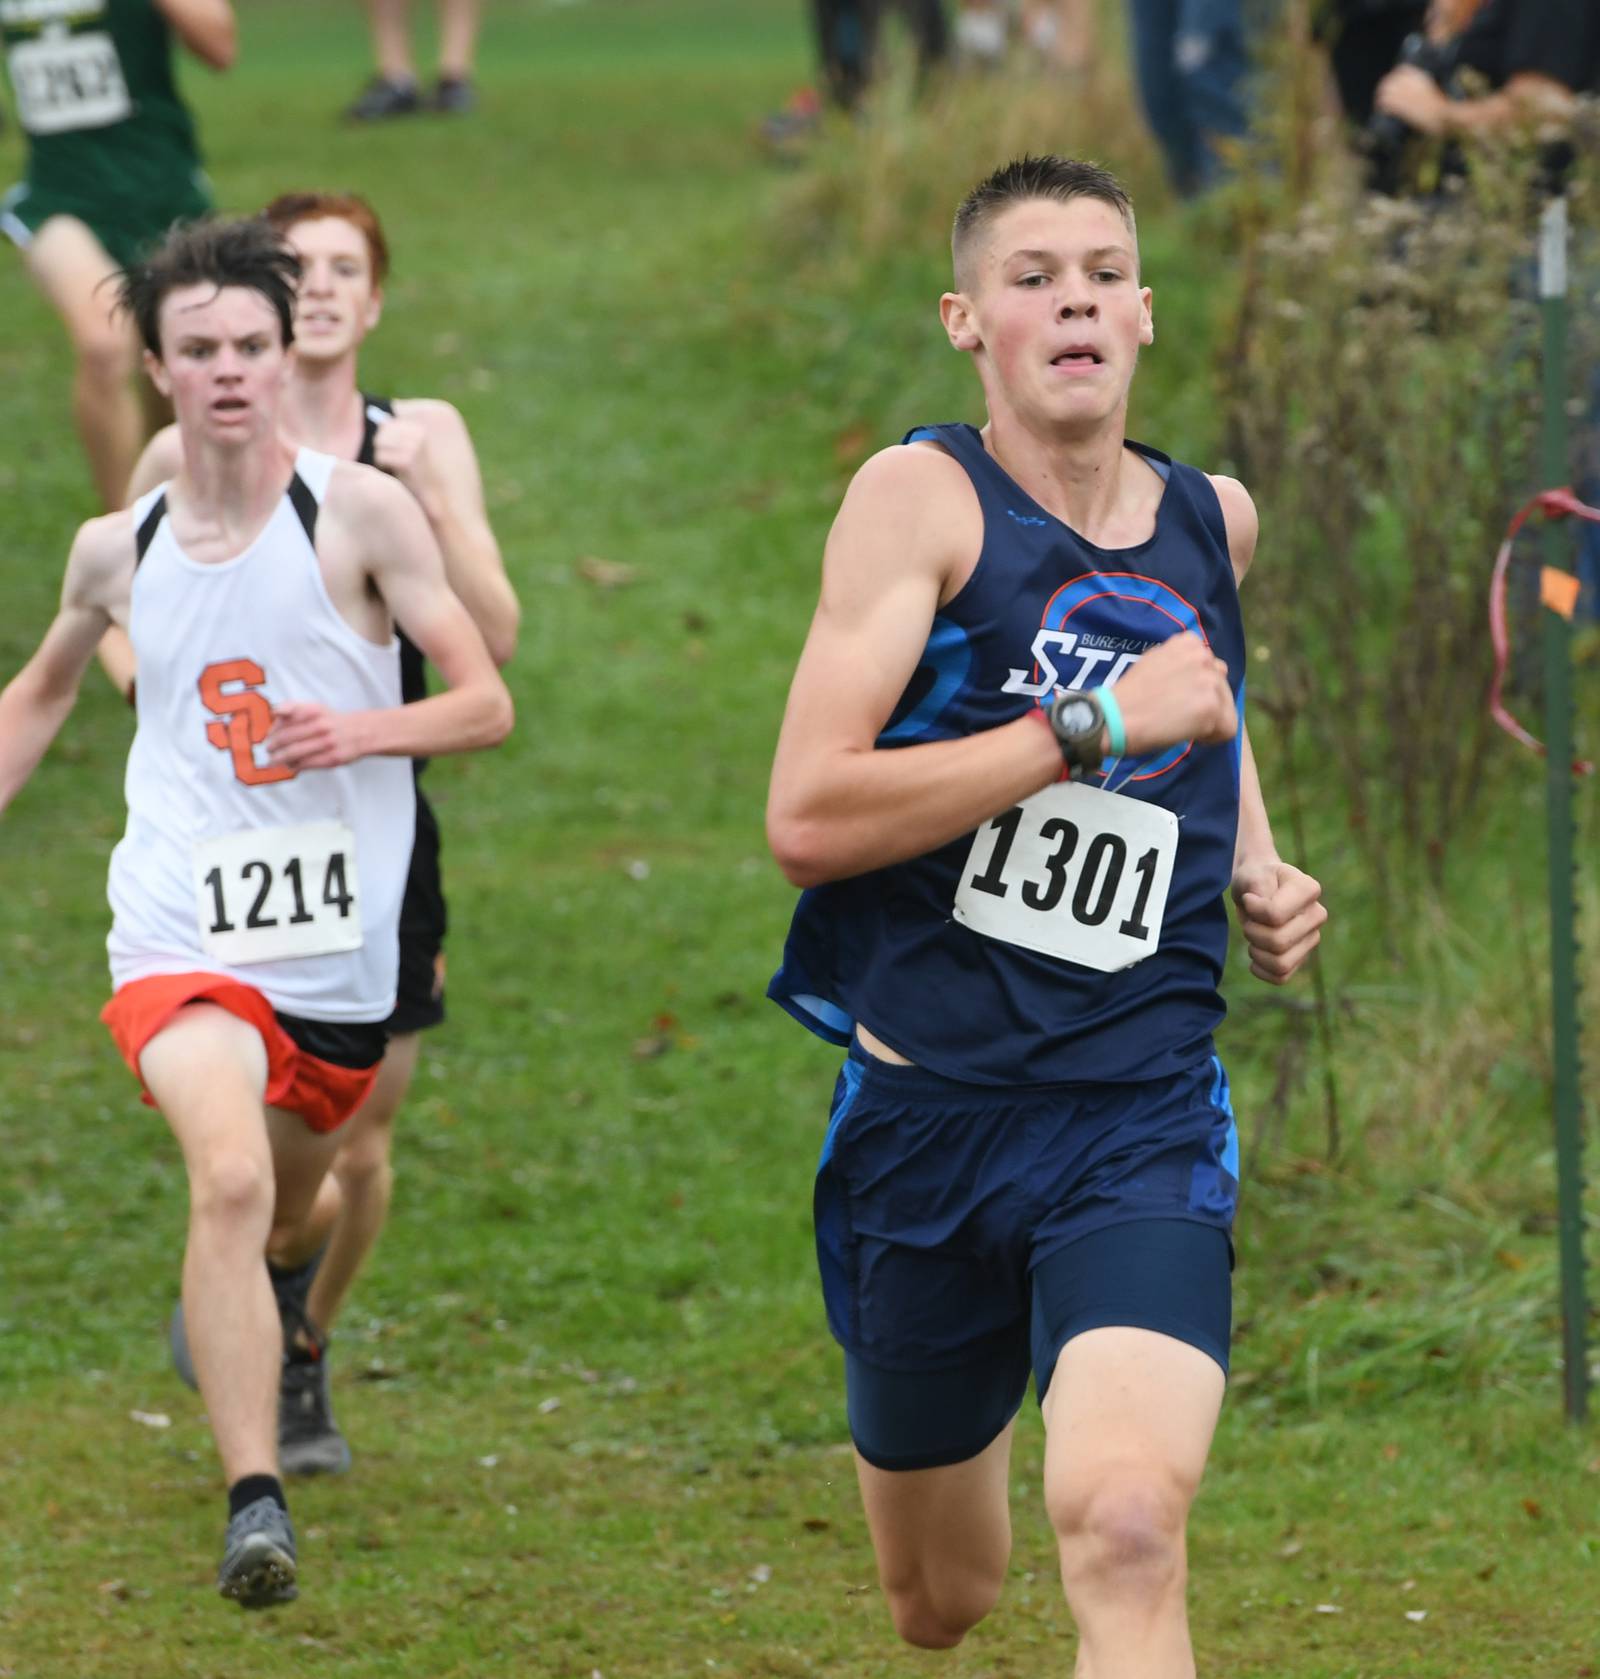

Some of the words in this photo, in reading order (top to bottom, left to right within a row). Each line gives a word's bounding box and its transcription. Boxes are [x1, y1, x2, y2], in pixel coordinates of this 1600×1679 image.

[1081, 633, 1141, 651] BUREAU
[204, 852, 354, 933] 1214
[970, 807, 1160, 941] 1301
